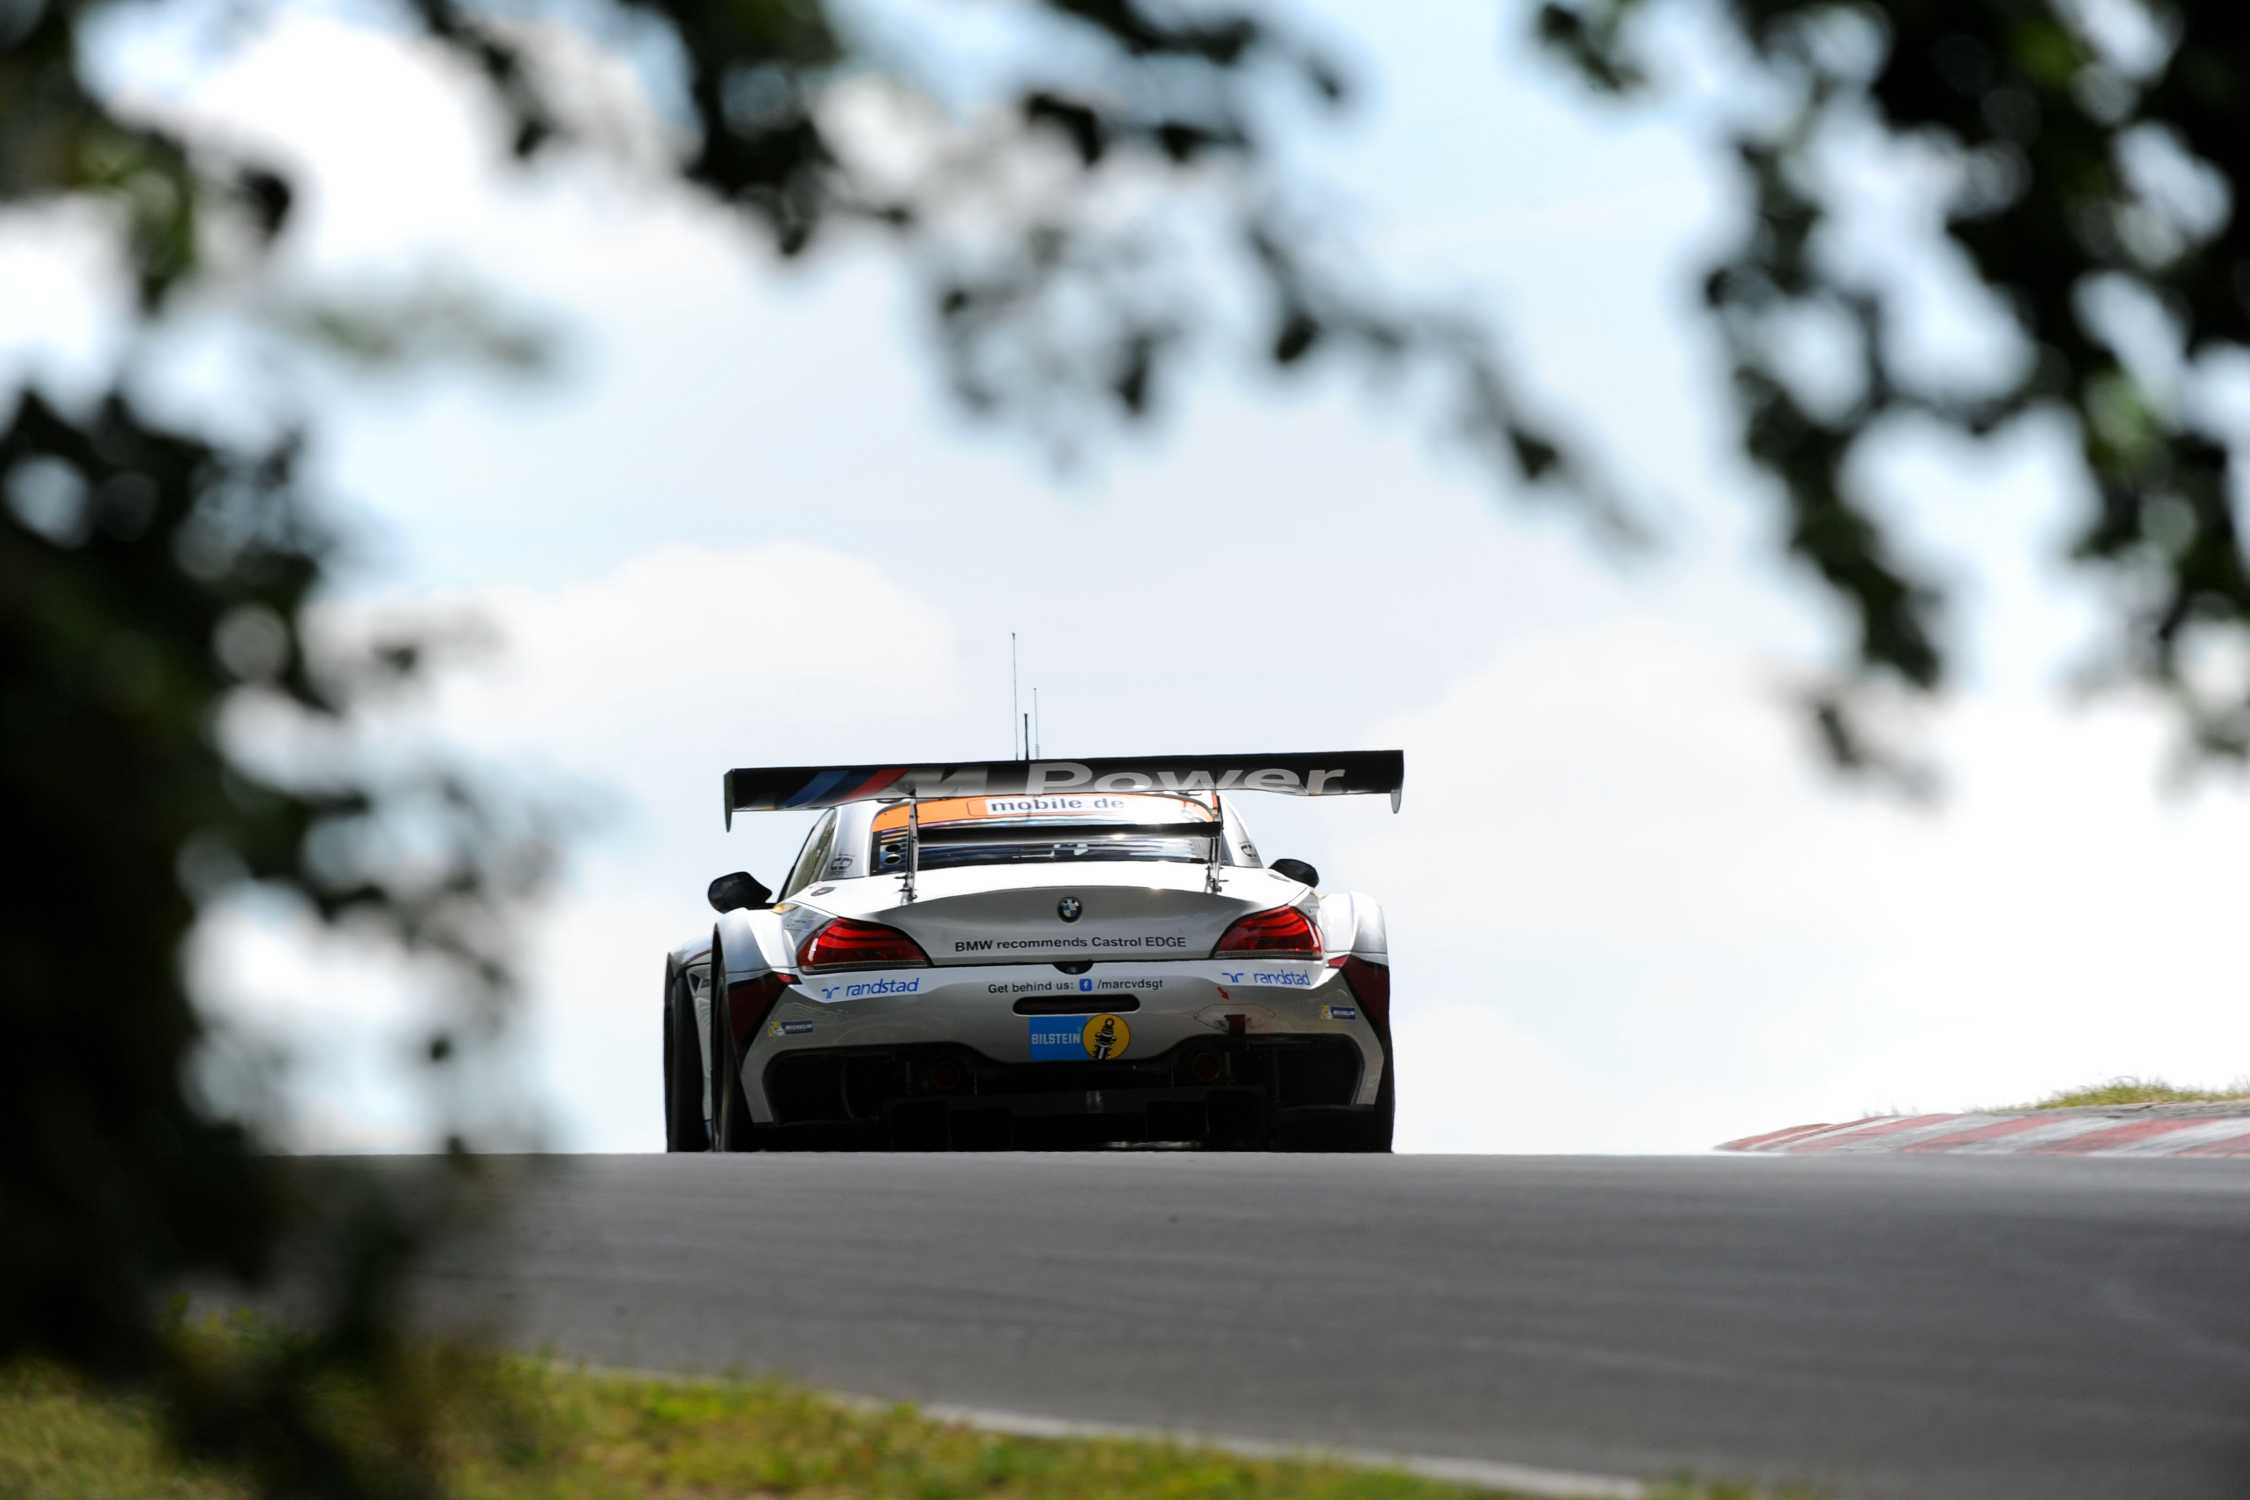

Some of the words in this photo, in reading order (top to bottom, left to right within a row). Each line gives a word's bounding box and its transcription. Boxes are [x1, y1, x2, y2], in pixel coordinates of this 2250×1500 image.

[1025, 761, 1347, 796] Power
[955, 940, 993, 952] BMW
[996, 937, 1088, 949] recommends
[1091, 936, 1142, 947] Castrol
[1145, 936, 1187, 948] EDGE
[1253, 969, 1311, 986] randstad
[846, 977, 920, 997] randstad
[988, 984, 1009, 994] Get
[1012, 981, 1053, 993] behind
[1056, 981, 1074, 990] us:
[1097, 978, 1163, 991] /marcvdsgt
[1031, 1032, 1081, 1045] BILSTEIN
